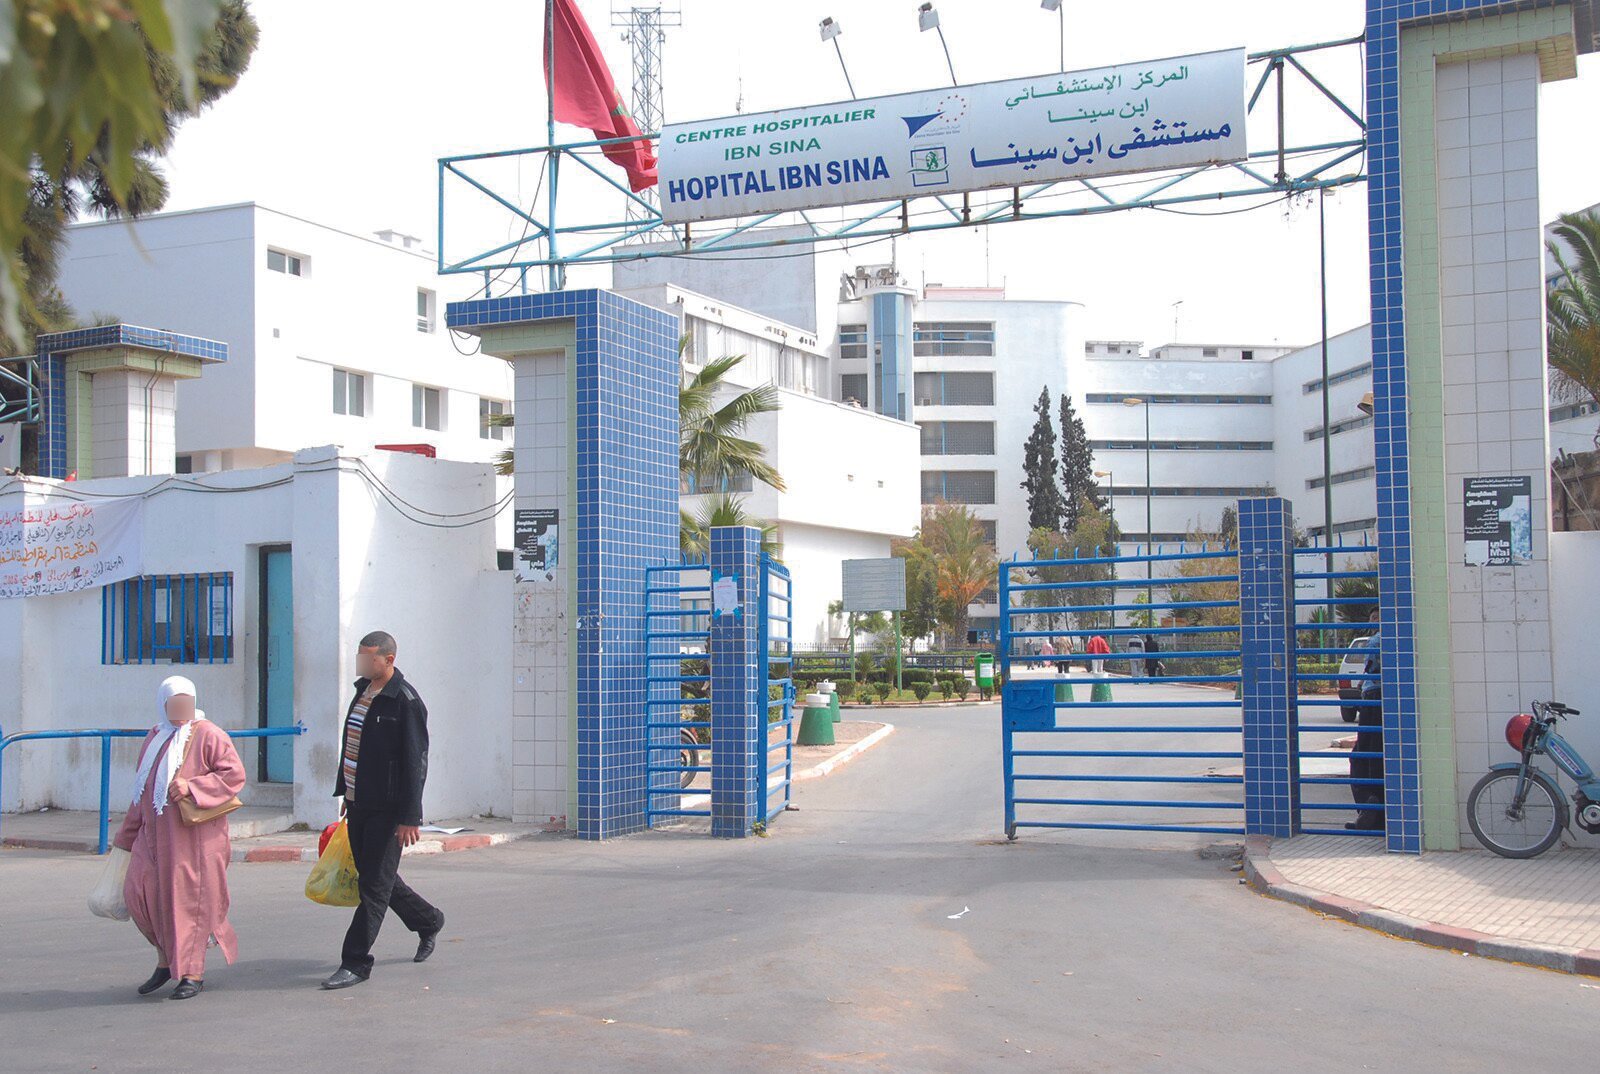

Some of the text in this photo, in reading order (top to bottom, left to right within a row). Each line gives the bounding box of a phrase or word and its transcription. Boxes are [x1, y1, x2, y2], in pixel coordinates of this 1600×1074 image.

[1131, 66, 1188, 90] المركز
[1048, 98, 1149, 123] ابن سينا
[675, 109, 876, 143] CENTRE HOSPITALIER
[724, 138, 821, 160] IBN SINA
[970, 119, 1232, 170] مستشفى ابن سينا
[668, 156, 890, 202] HOPITAL IBN SINA
[65, 541, 98, 560] المنظمة
[1490, 548, 1510, 557] Mai
